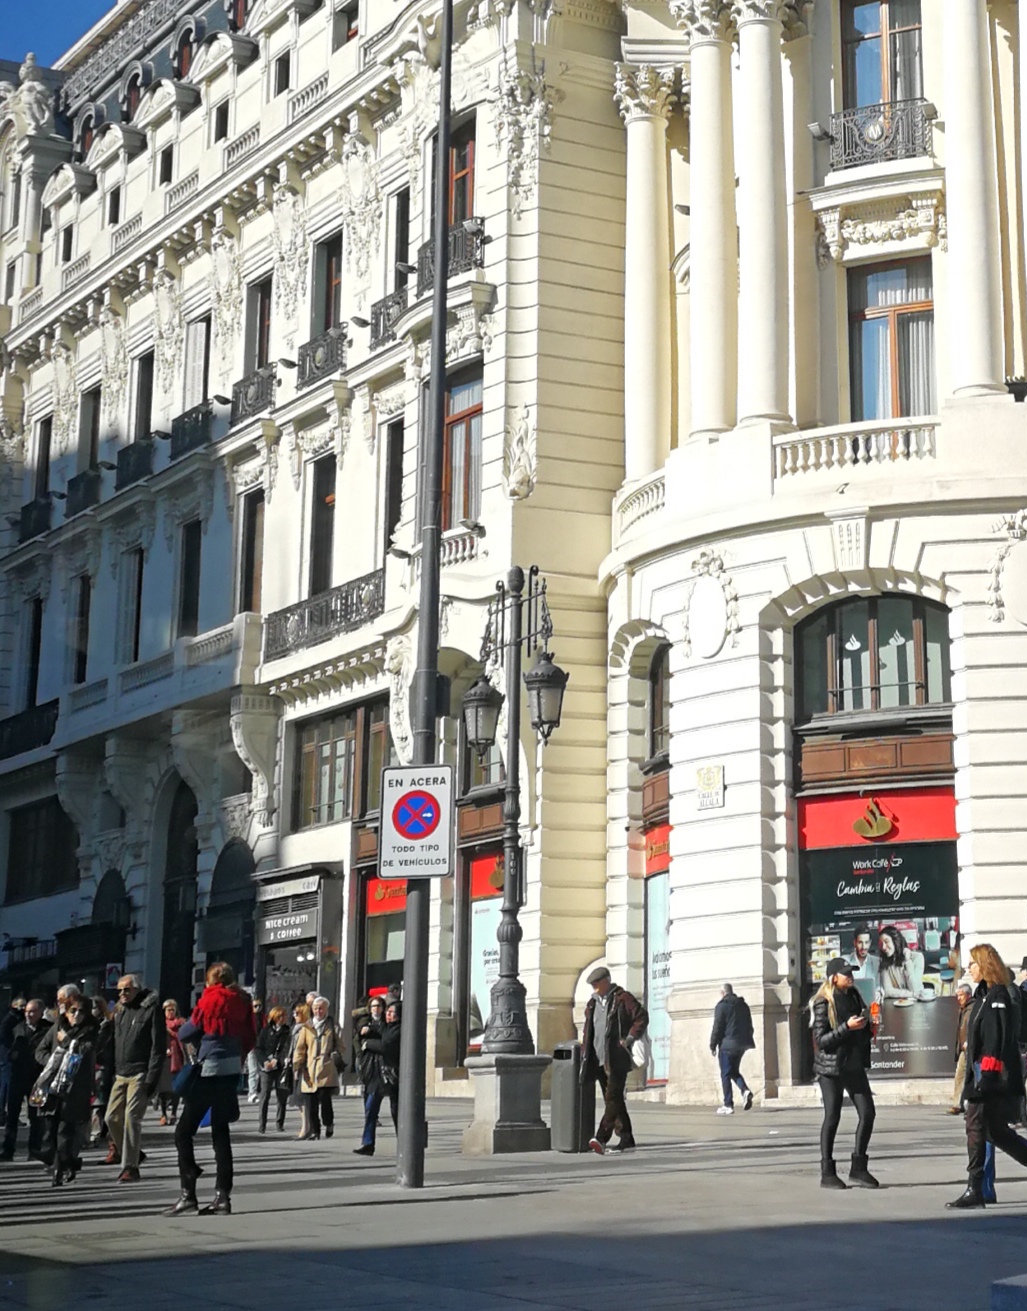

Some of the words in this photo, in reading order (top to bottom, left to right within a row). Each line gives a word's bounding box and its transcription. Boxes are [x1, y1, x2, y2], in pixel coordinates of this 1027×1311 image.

[388, 779, 403, 788] EN
[409, 777, 446, 787] ACERA
[420, 844, 440, 852] TIPO
[383, 859, 394, 867] DE
[398, 856, 447, 867] VEHÍCULOS
[852, 857, 872, 870] Work
[872, 857, 889, 868] Café
[836, 879, 875, 897] Cambia
[883, 876, 921, 900] Reglas
[871, 1060, 905, 1069] Santander
